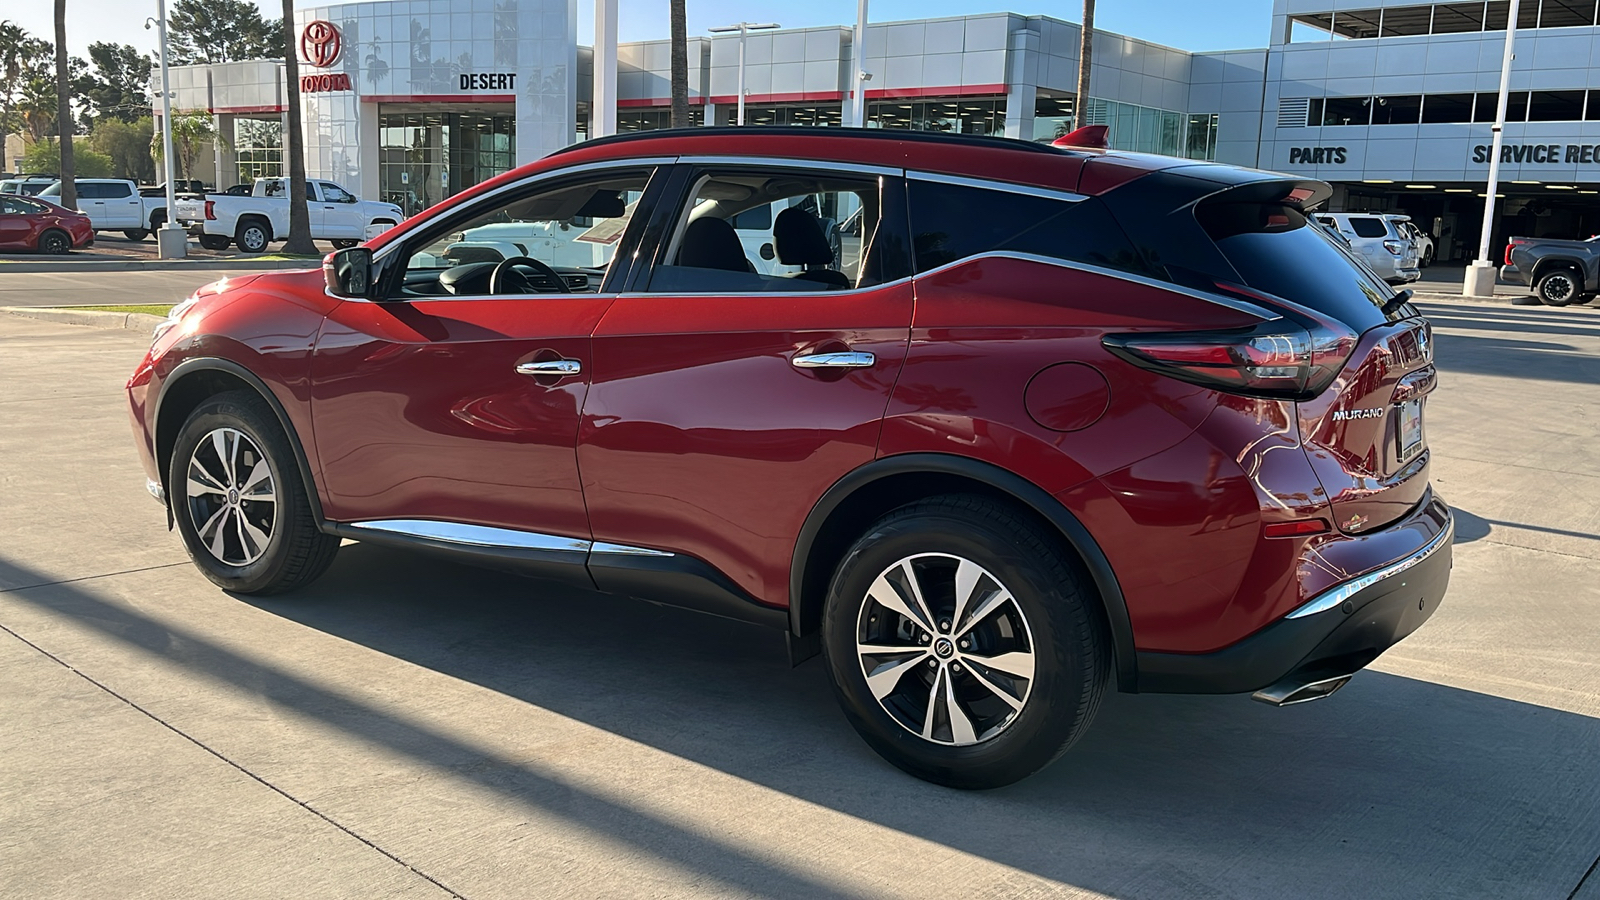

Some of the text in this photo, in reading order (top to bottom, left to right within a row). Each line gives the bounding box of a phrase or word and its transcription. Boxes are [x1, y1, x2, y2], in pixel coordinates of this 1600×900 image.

[299, 73, 352, 93] TOYOTA
[460, 73, 517, 90] DESERT
[1289, 146, 1347, 164] PARTS
[1332, 407, 1384, 421] MURANO
